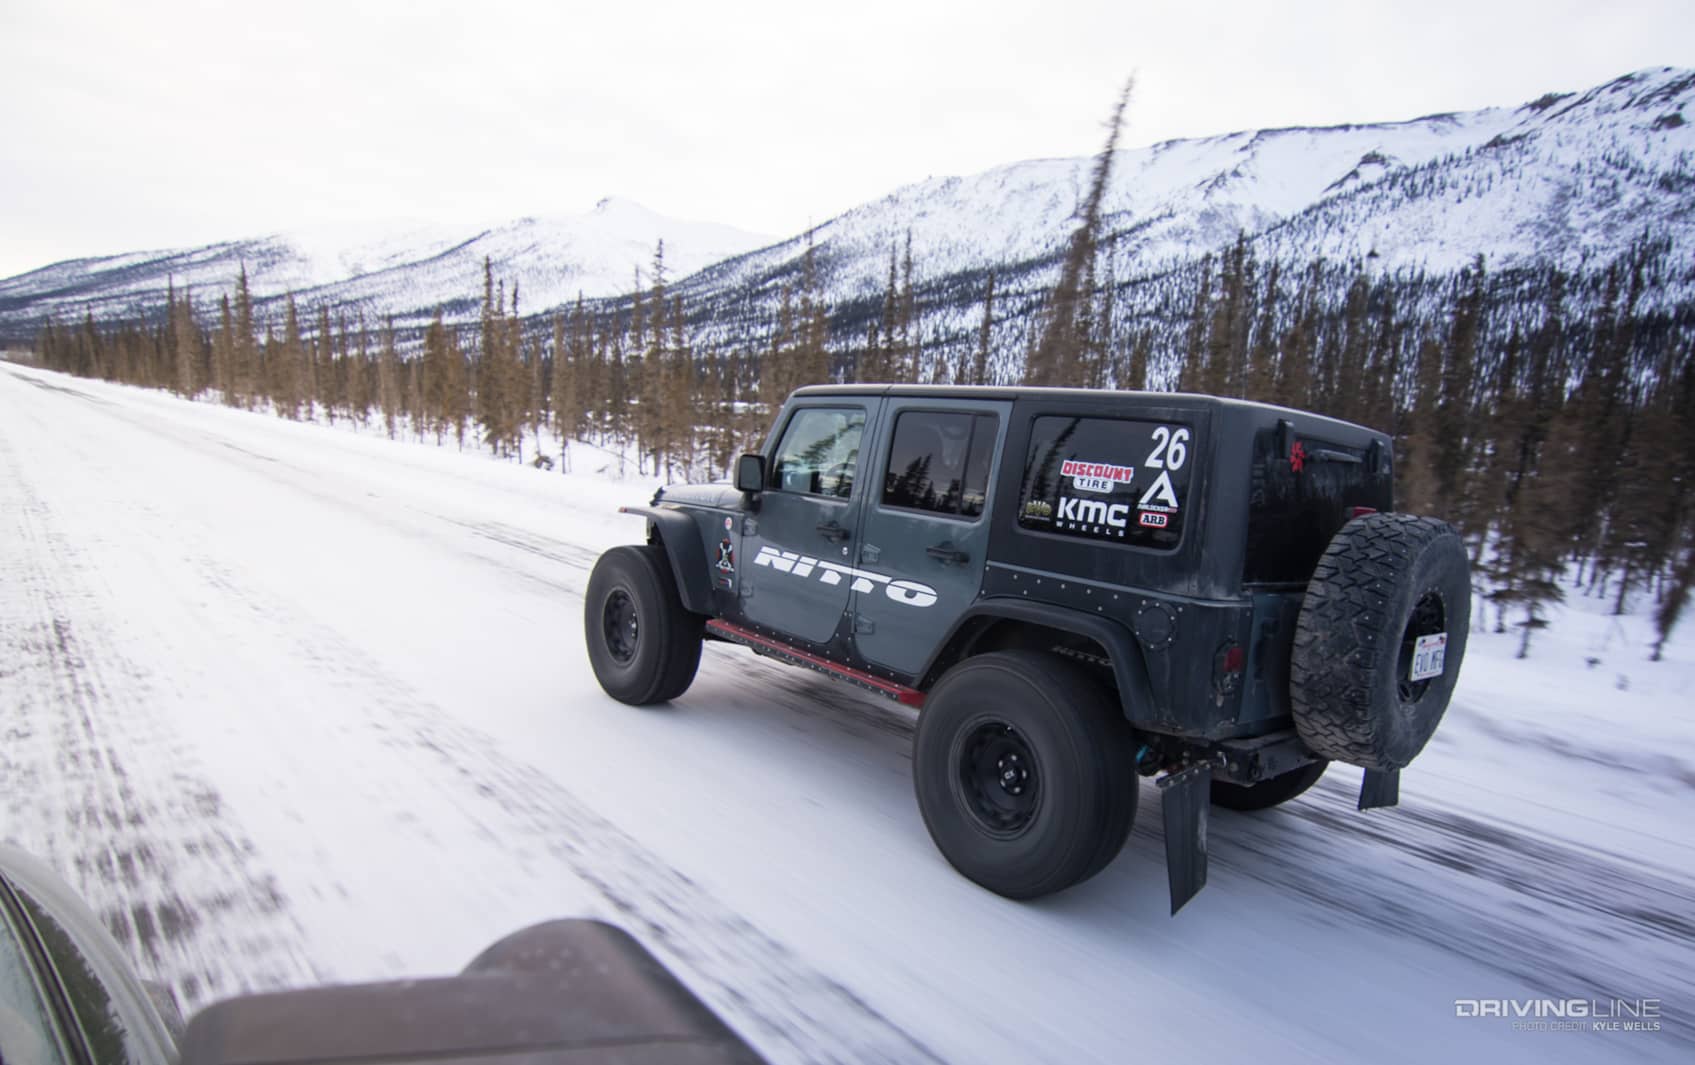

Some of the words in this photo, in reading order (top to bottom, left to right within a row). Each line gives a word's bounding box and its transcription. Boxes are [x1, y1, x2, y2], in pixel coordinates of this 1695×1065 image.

[1144, 426, 1190, 471] 26
[1062, 461, 1133, 482] DISCOUNT
[1079, 477, 1108, 490] TIRE
[1056, 497, 1130, 528] KMC
[1142, 513, 1166, 525] ARB
[1056, 521, 1124, 537] WHEELS
[753, 546, 938, 607] NITTO
